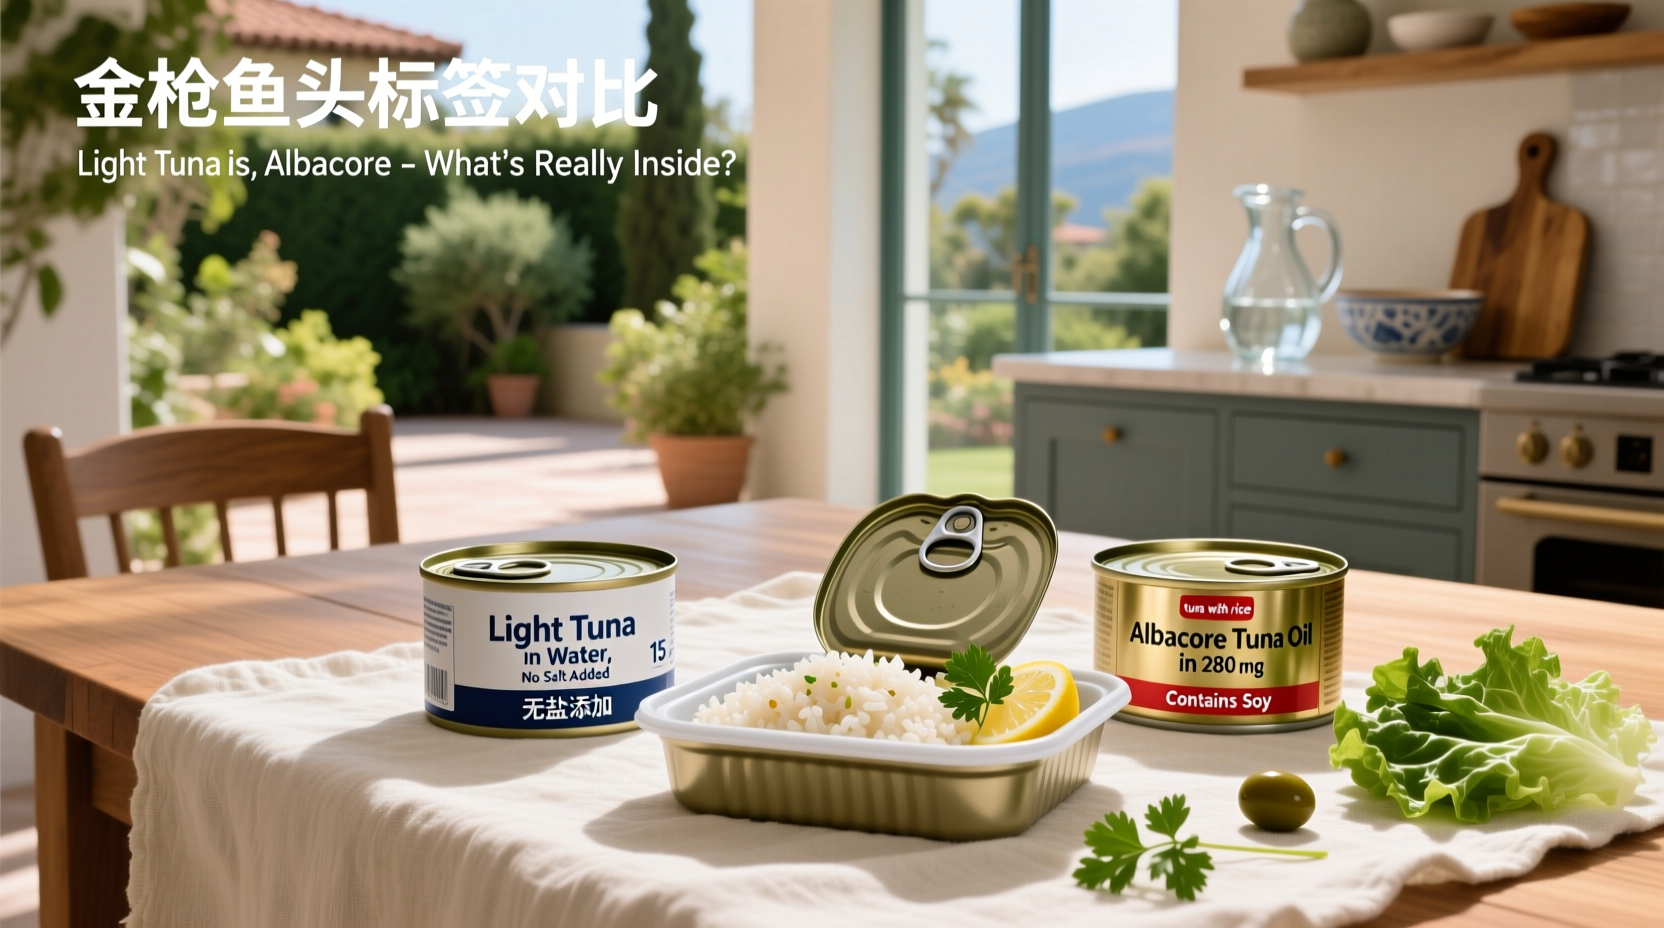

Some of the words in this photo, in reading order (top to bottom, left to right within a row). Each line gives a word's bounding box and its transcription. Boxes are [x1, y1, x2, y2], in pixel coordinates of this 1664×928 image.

[489, 615, 563, 649] Light
[569, 614, 636, 642] Tuna
[1130, 621, 1227, 649] Albacore
[1232, 628, 1284, 649] Tuna
[1287, 622, 1313, 647] Oil
[547, 646, 612, 665] Water,
[650, 639, 667, 663] 15
[522, 671, 540, 683] No
[544, 669, 567, 682] Salt
[570, 666, 610, 682] Added
[1179, 652, 1197, 673] in
[1201, 656, 1236, 673] 280
[1239, 661, 1264, 678] mg
[522, 694, 613, 721] 无盐添加
[1165, 690, 1237, 709] Contains
[1242, 693, 1272, 713] Soy
